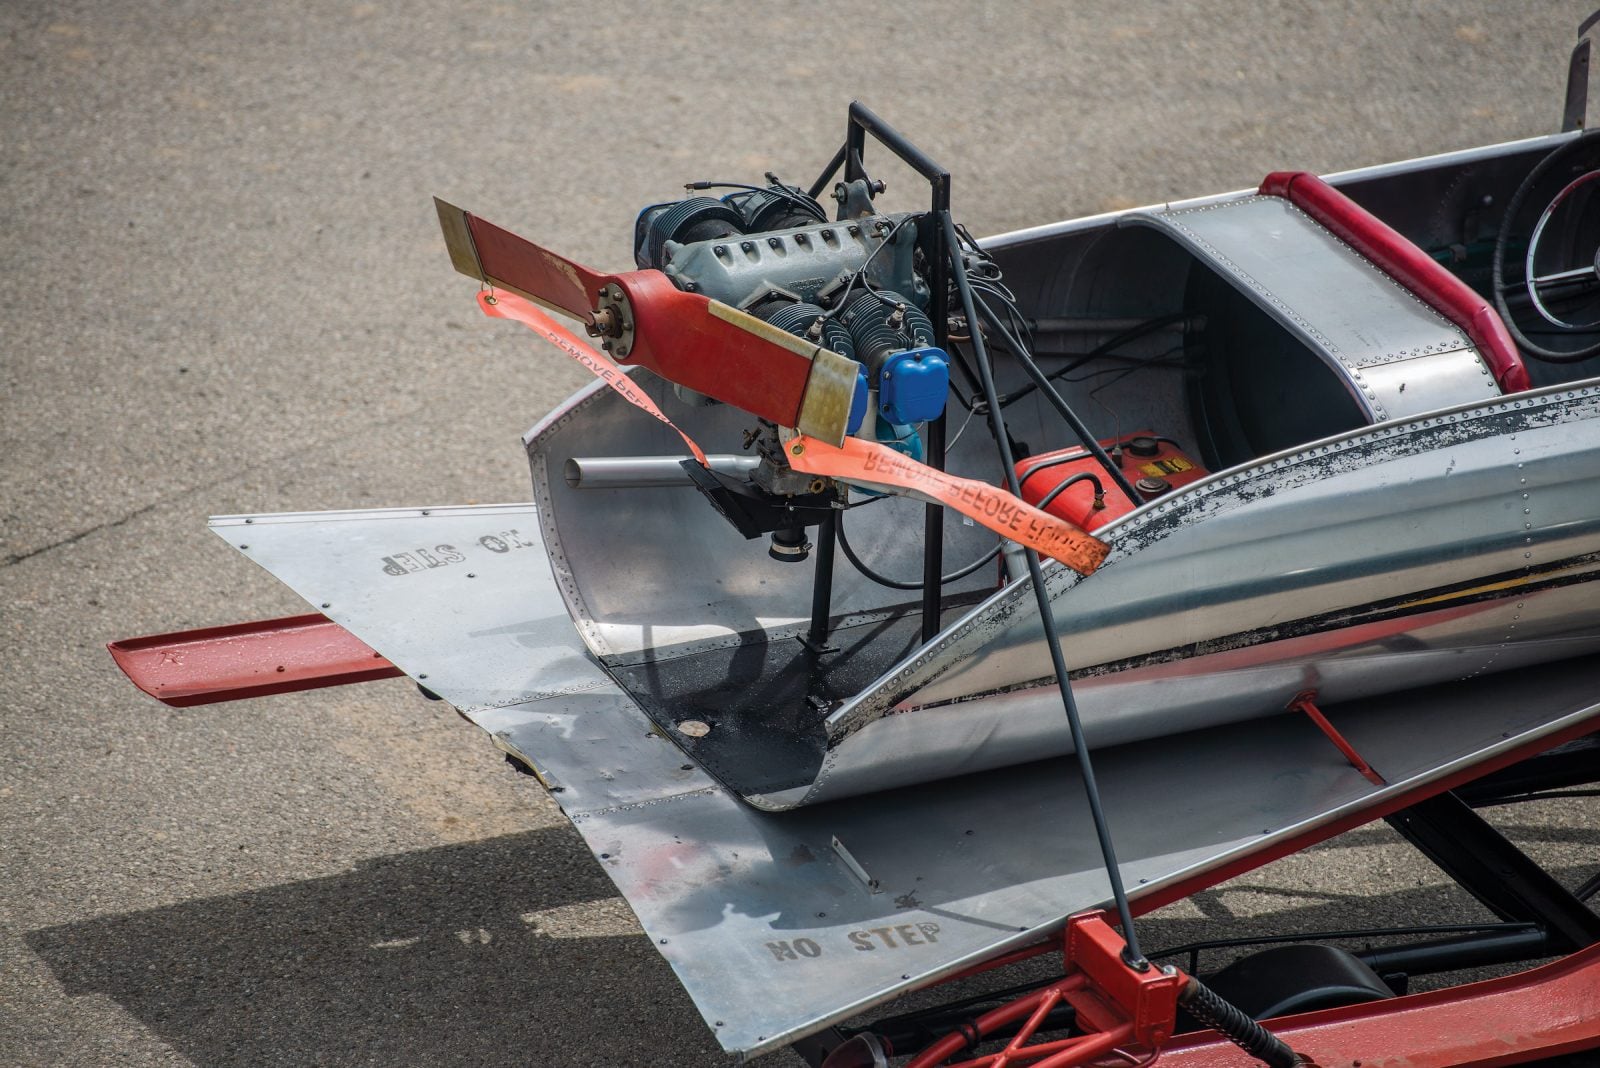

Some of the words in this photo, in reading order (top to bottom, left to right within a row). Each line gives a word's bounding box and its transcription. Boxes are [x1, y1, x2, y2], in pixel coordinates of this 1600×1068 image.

[381, 544, 466, 576] STEP
[765, 937, 821, 962] NO
[847, 922, 940, 952] STEP
